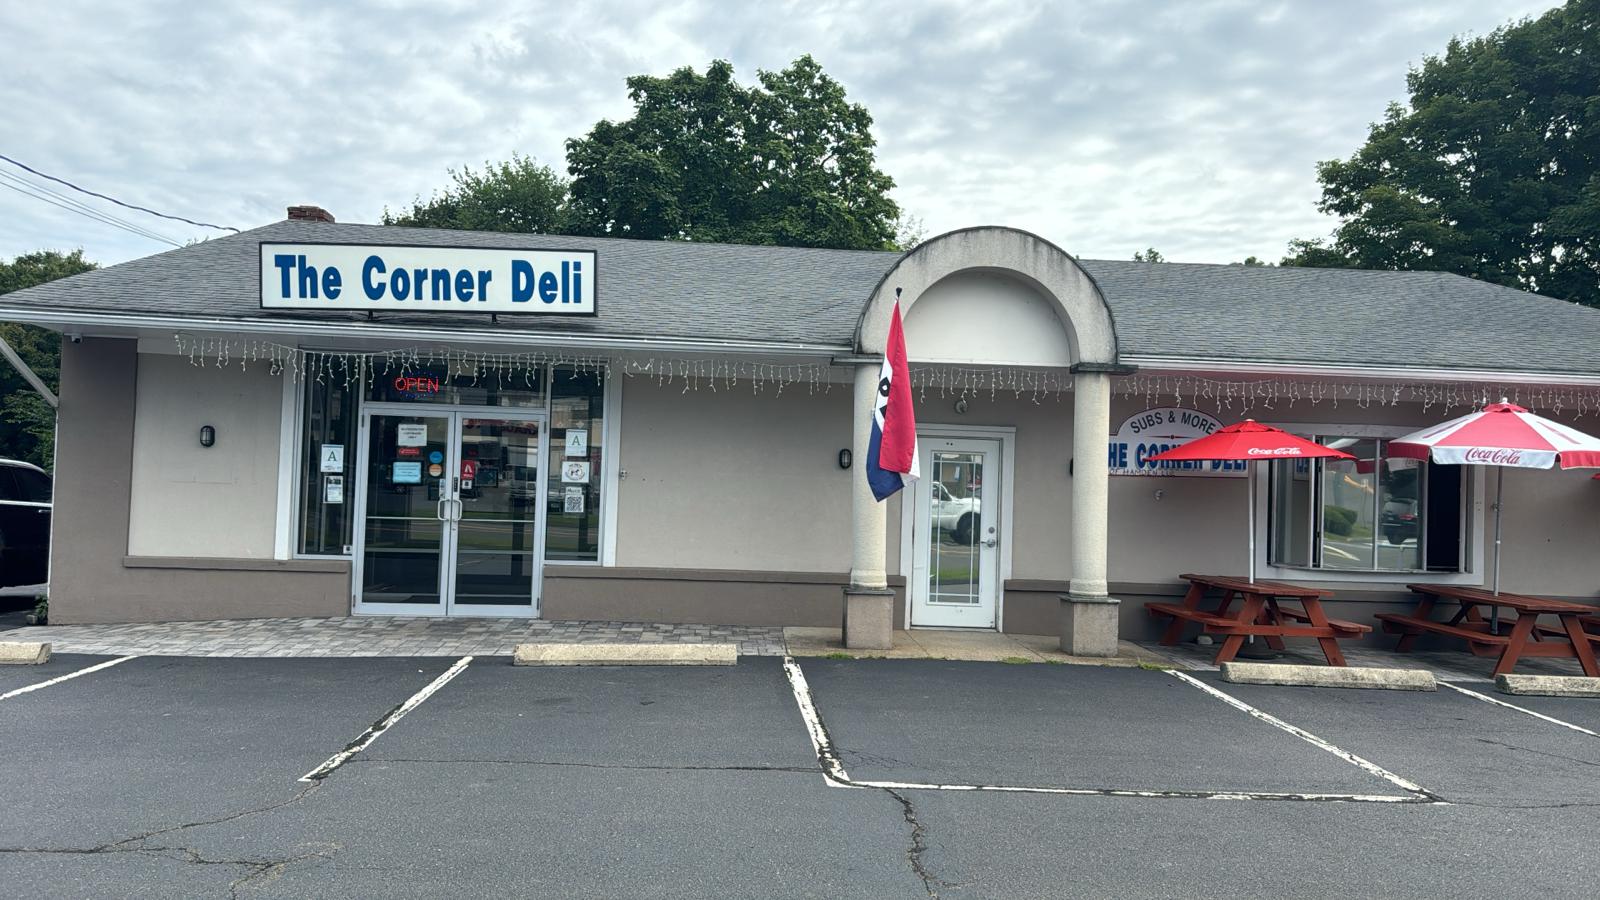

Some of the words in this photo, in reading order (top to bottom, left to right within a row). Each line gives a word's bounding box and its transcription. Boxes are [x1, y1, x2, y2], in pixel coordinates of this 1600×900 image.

[274, 254, 342, 300] The
[362, 255, 492, 302] Corner
[511, 259, 582, 304] Deli
[395, 376, 439, 392] OPEN
[1130, 411, 1163, 433] SUBS
[1168, 410, 1176, 423] &
[1181, 411, 1216, 435] MORE
[572, 435, 580, 446] A
[327, 450, 337, 461] A
[1108, 442, 1128, 468] HE
